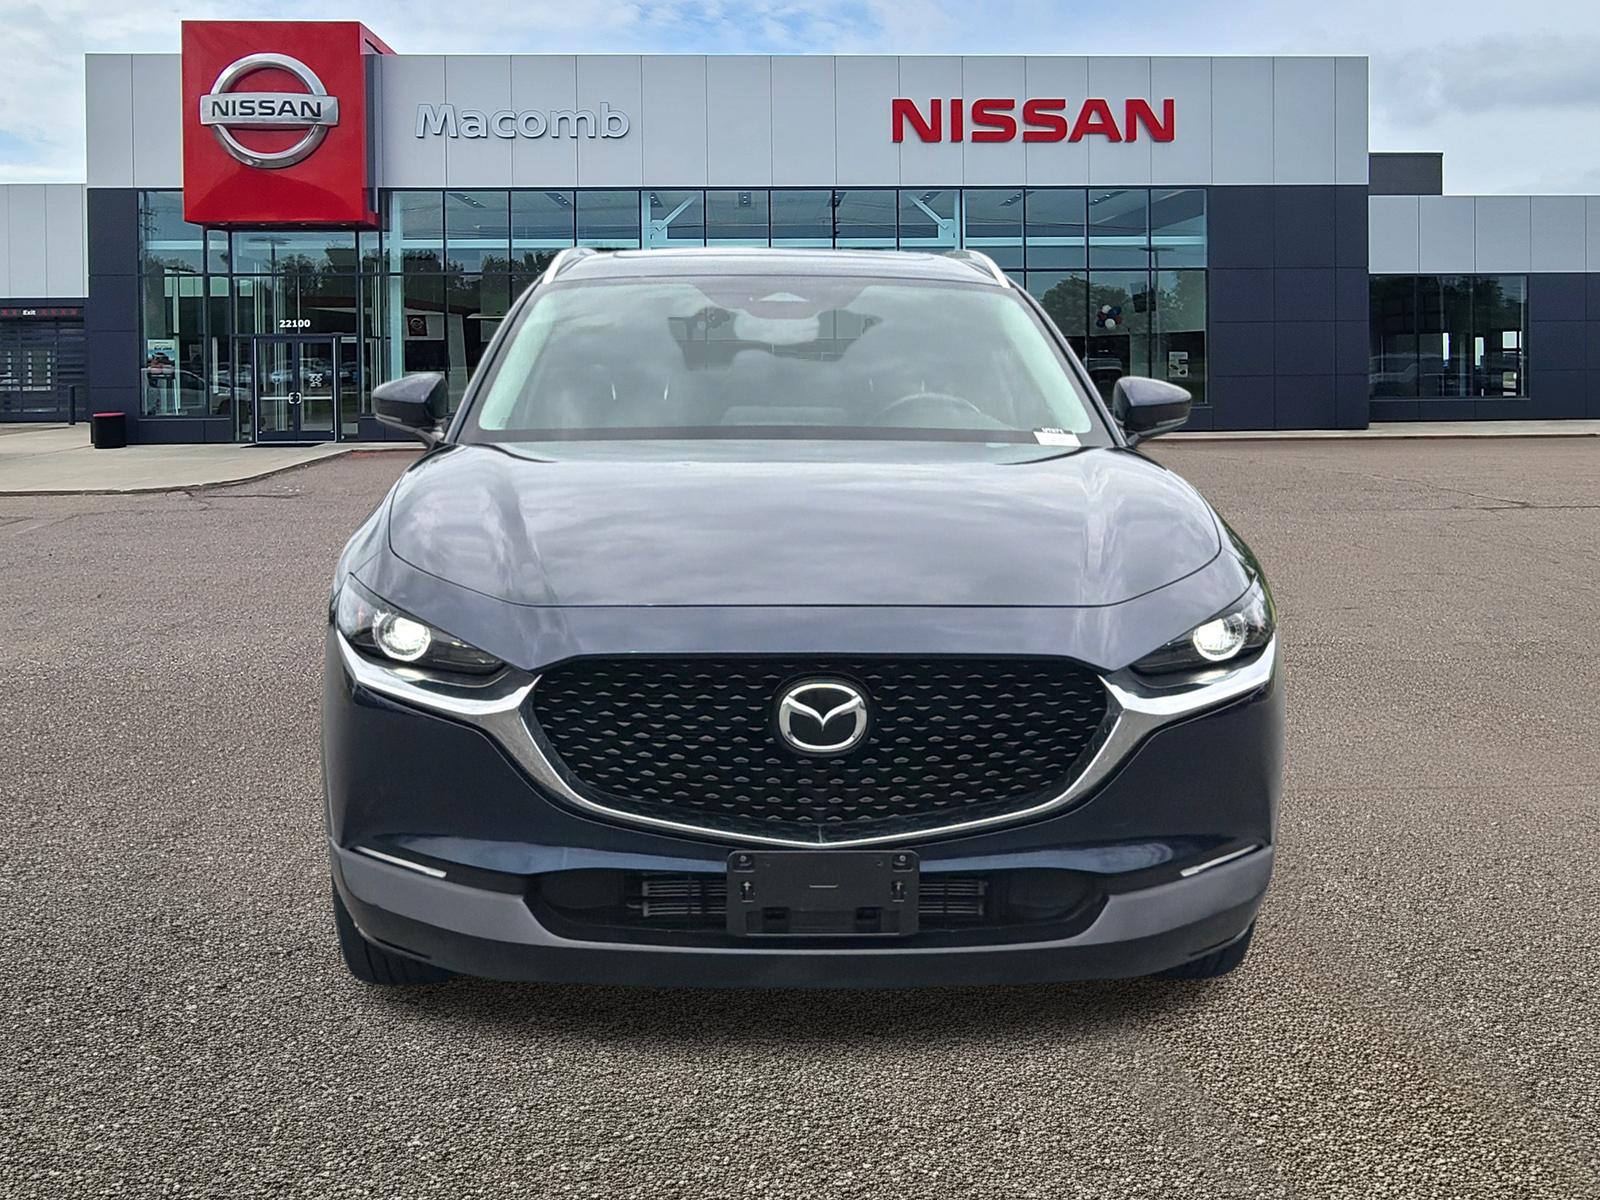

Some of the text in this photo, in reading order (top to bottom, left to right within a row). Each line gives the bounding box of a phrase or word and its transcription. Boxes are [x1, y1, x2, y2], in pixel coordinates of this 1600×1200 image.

[211, 100, 322, 118] NISSAN
[415, 101, 630, 138] Macomb
[892, 98, 1175, 142] NISSAN
[279, 319, 311, 328] 22100
